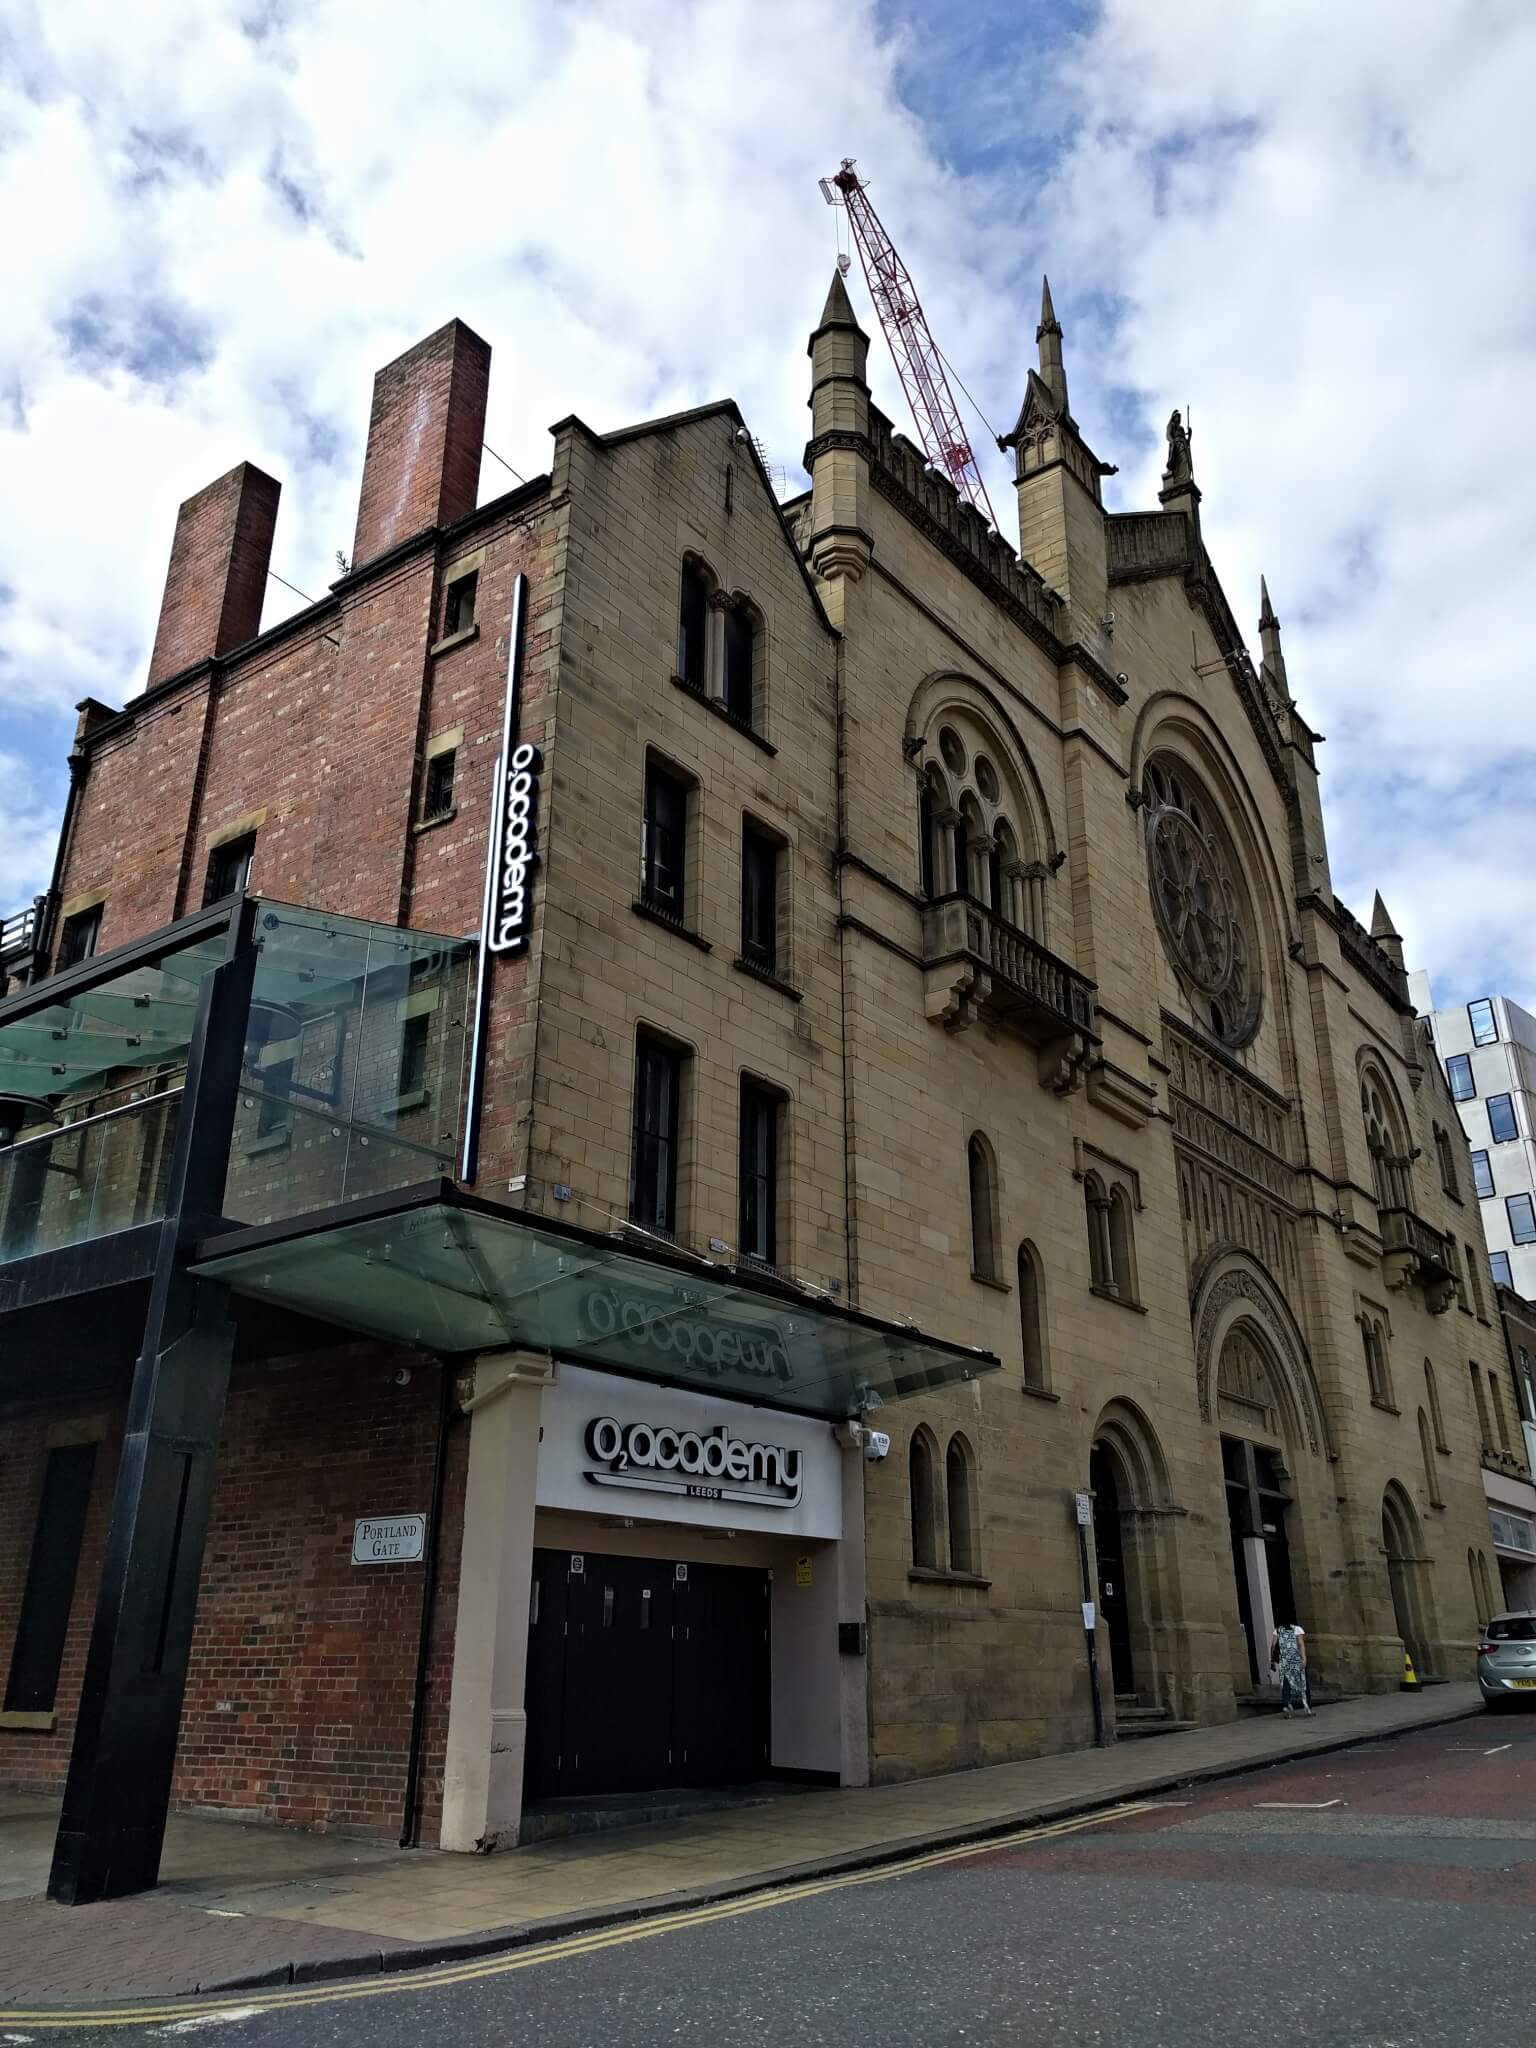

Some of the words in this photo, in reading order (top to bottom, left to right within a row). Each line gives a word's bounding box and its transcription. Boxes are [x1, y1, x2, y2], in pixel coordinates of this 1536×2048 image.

[690, 1486, 718, 1498] LEEDS
[362, 1524, 416, 1540] PORTLAND
[372, 1540, 400, 1556] GATE
